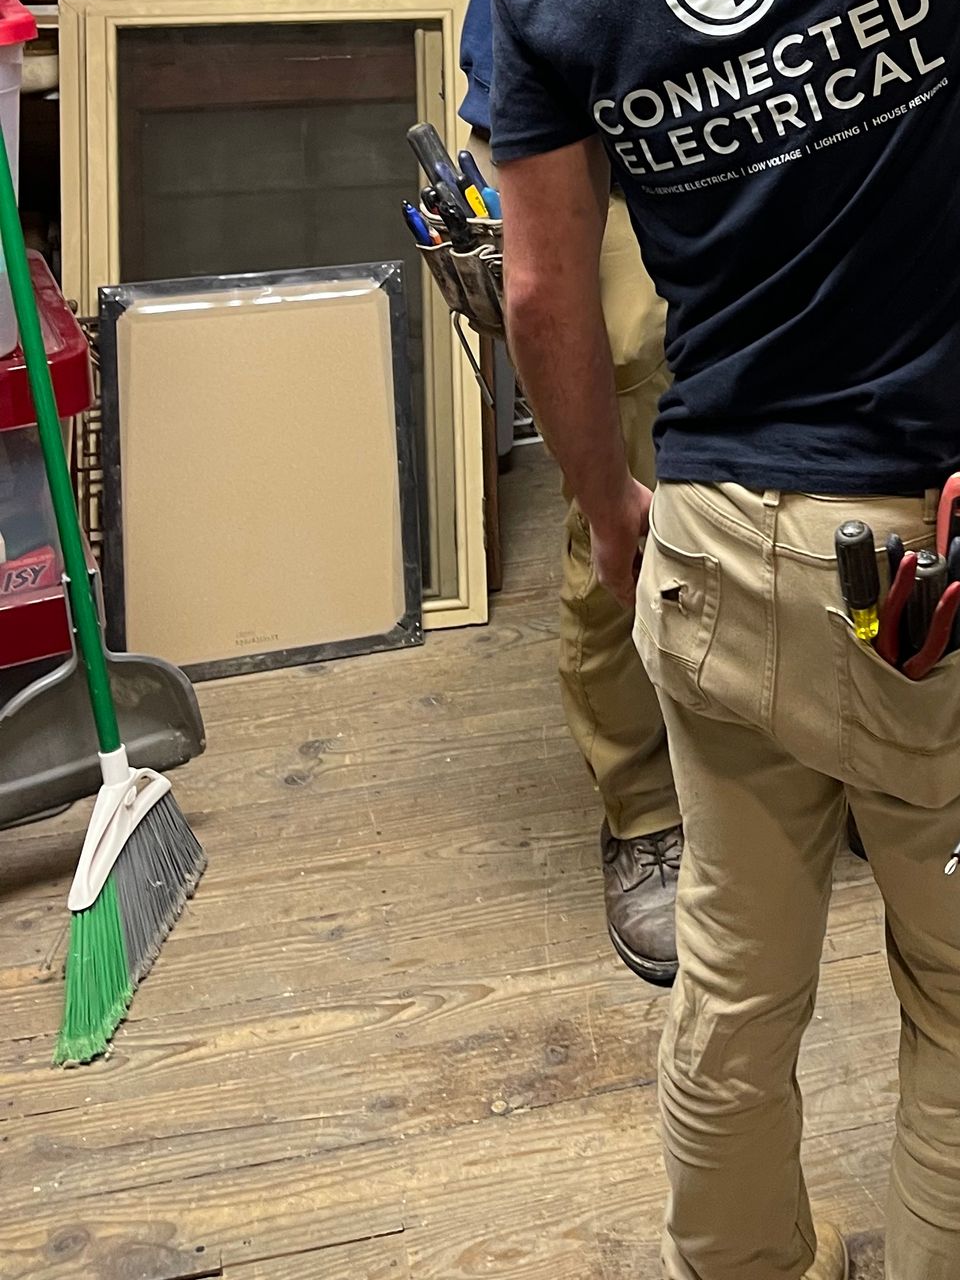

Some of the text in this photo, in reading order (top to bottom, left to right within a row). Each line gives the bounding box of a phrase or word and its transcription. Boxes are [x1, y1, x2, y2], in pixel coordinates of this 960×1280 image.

[614, 37, 946, 175] ELECTRICAL
[684, 170, 740, 192] ELECTRICAL
[747, 161, 768, 175] LOW
[767, 148, 803, 168] VOLTAGE
[814, 126, 861, 151] LIGHTING
[872, 104, 908, 126] HOUSE
